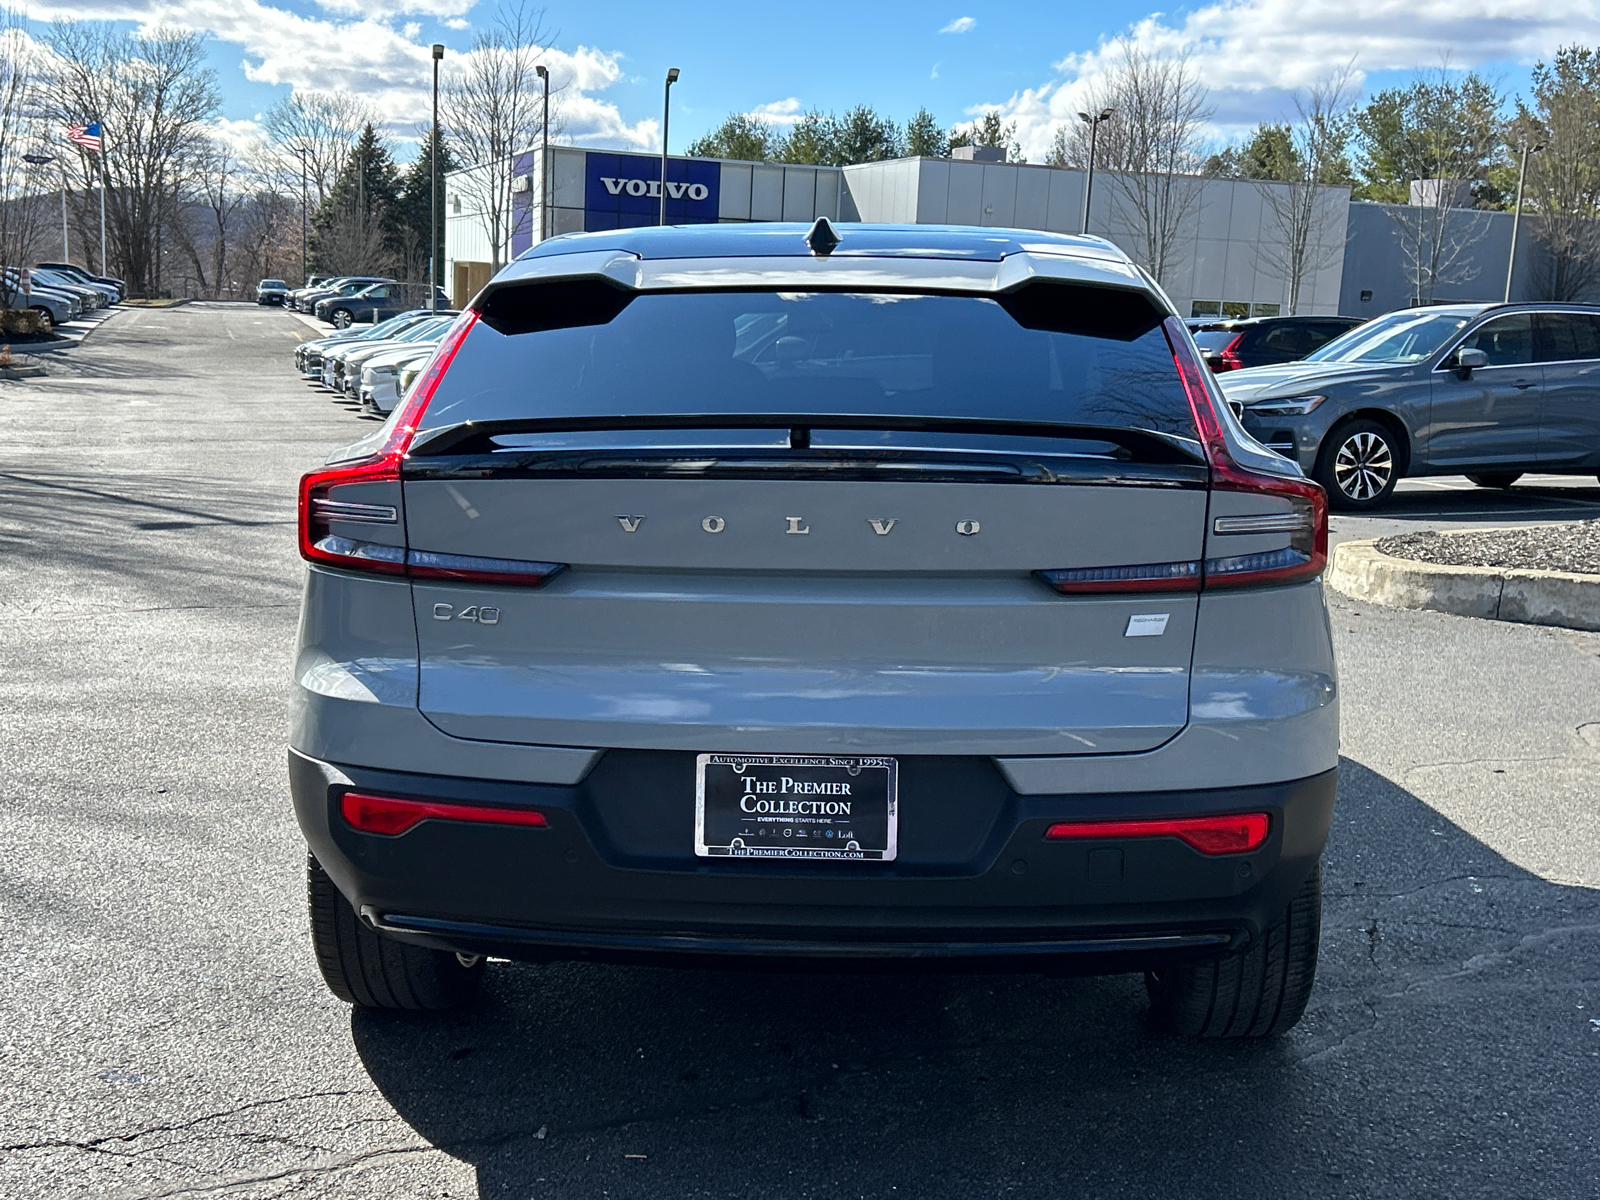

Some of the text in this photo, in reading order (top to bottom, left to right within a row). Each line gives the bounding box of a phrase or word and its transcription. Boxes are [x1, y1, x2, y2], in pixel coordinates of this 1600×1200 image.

[600, 177, 709, 201] VOLVO
[614, 513, 981, 536] VOLVO
[859, 758, 883, 766] 1995
[740, 776, 852, 796] THE PREMIER
[740, 794, 852, 815] COLLECTION
